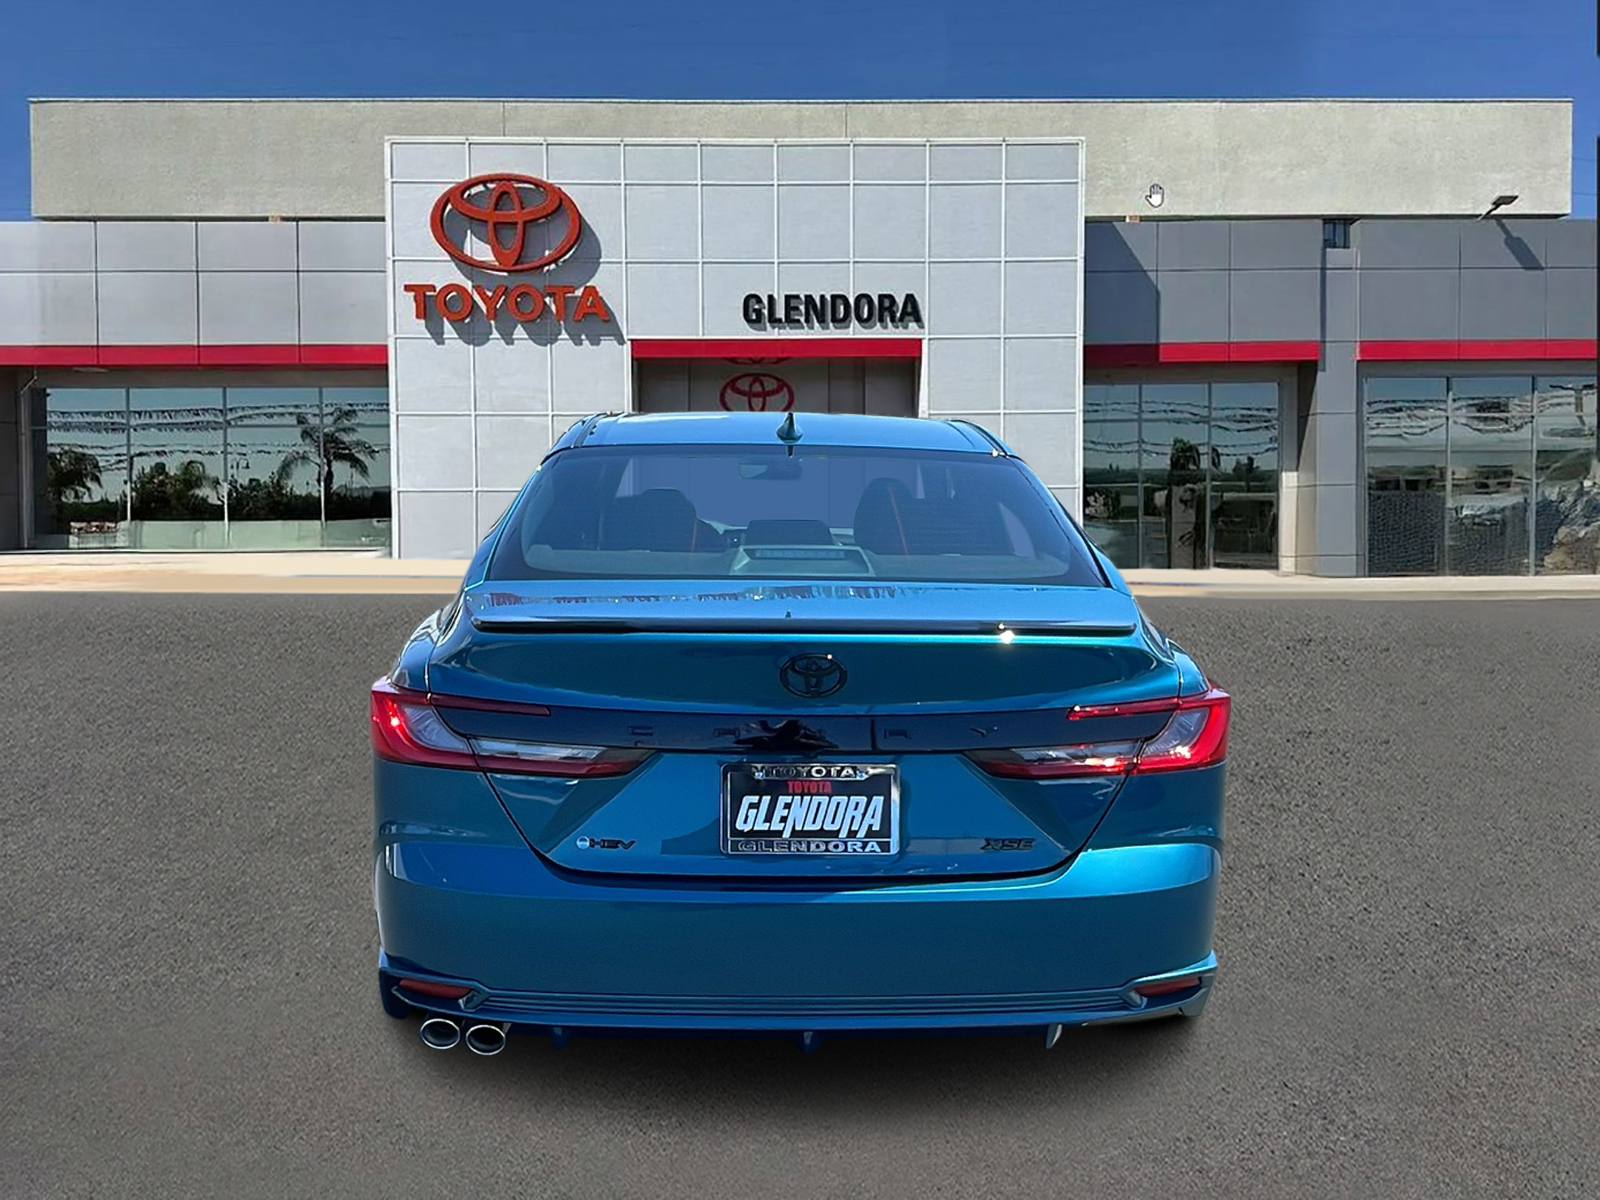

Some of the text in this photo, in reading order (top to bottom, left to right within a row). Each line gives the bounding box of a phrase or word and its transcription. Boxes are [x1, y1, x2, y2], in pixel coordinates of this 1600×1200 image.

[404, 283, 610, 321] TOYOTA
[743, 293, 923, 325] GLENDORA
[628, 725, 999, 739] CARY
[768, 765, 856, 778] TOYOTA
[787, 780, 832, 794] TOYOTA
[736, 796, 884, 838] GLENDORA
[738, 840, 881, 853] GLENDORA
[980, 838, 1035, 850] XSE
